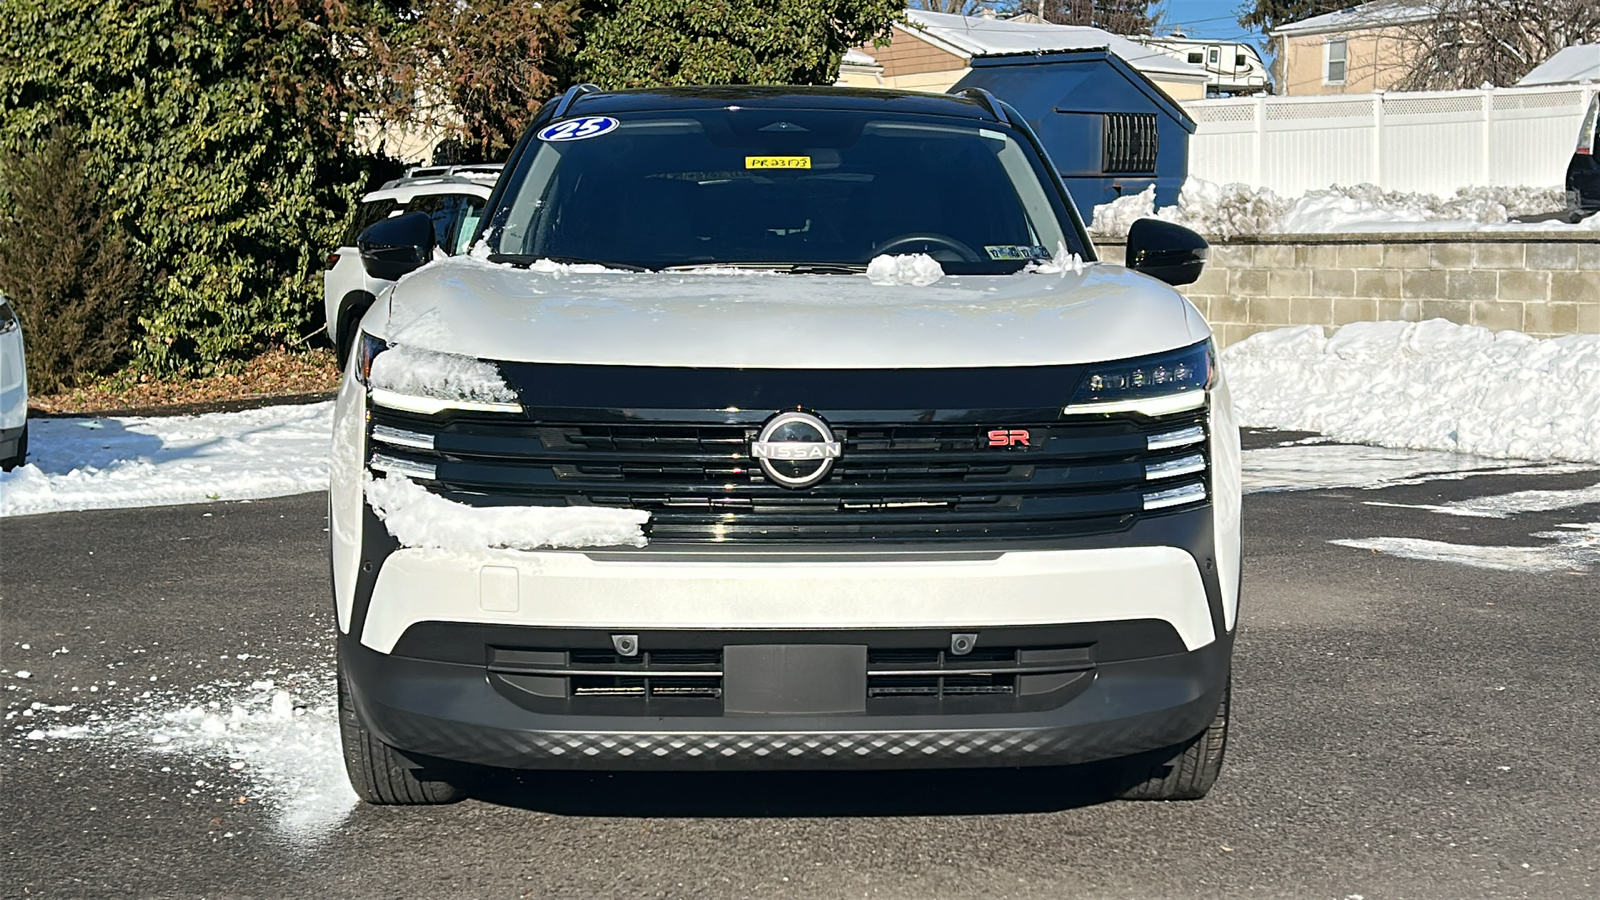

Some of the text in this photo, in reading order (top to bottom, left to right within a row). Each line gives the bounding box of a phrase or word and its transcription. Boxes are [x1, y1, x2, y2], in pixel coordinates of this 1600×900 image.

[548, 118, 604, 139] 25
[988, 430, 1030, 446] SR
[754, 444, 839, 458] NISSAN
